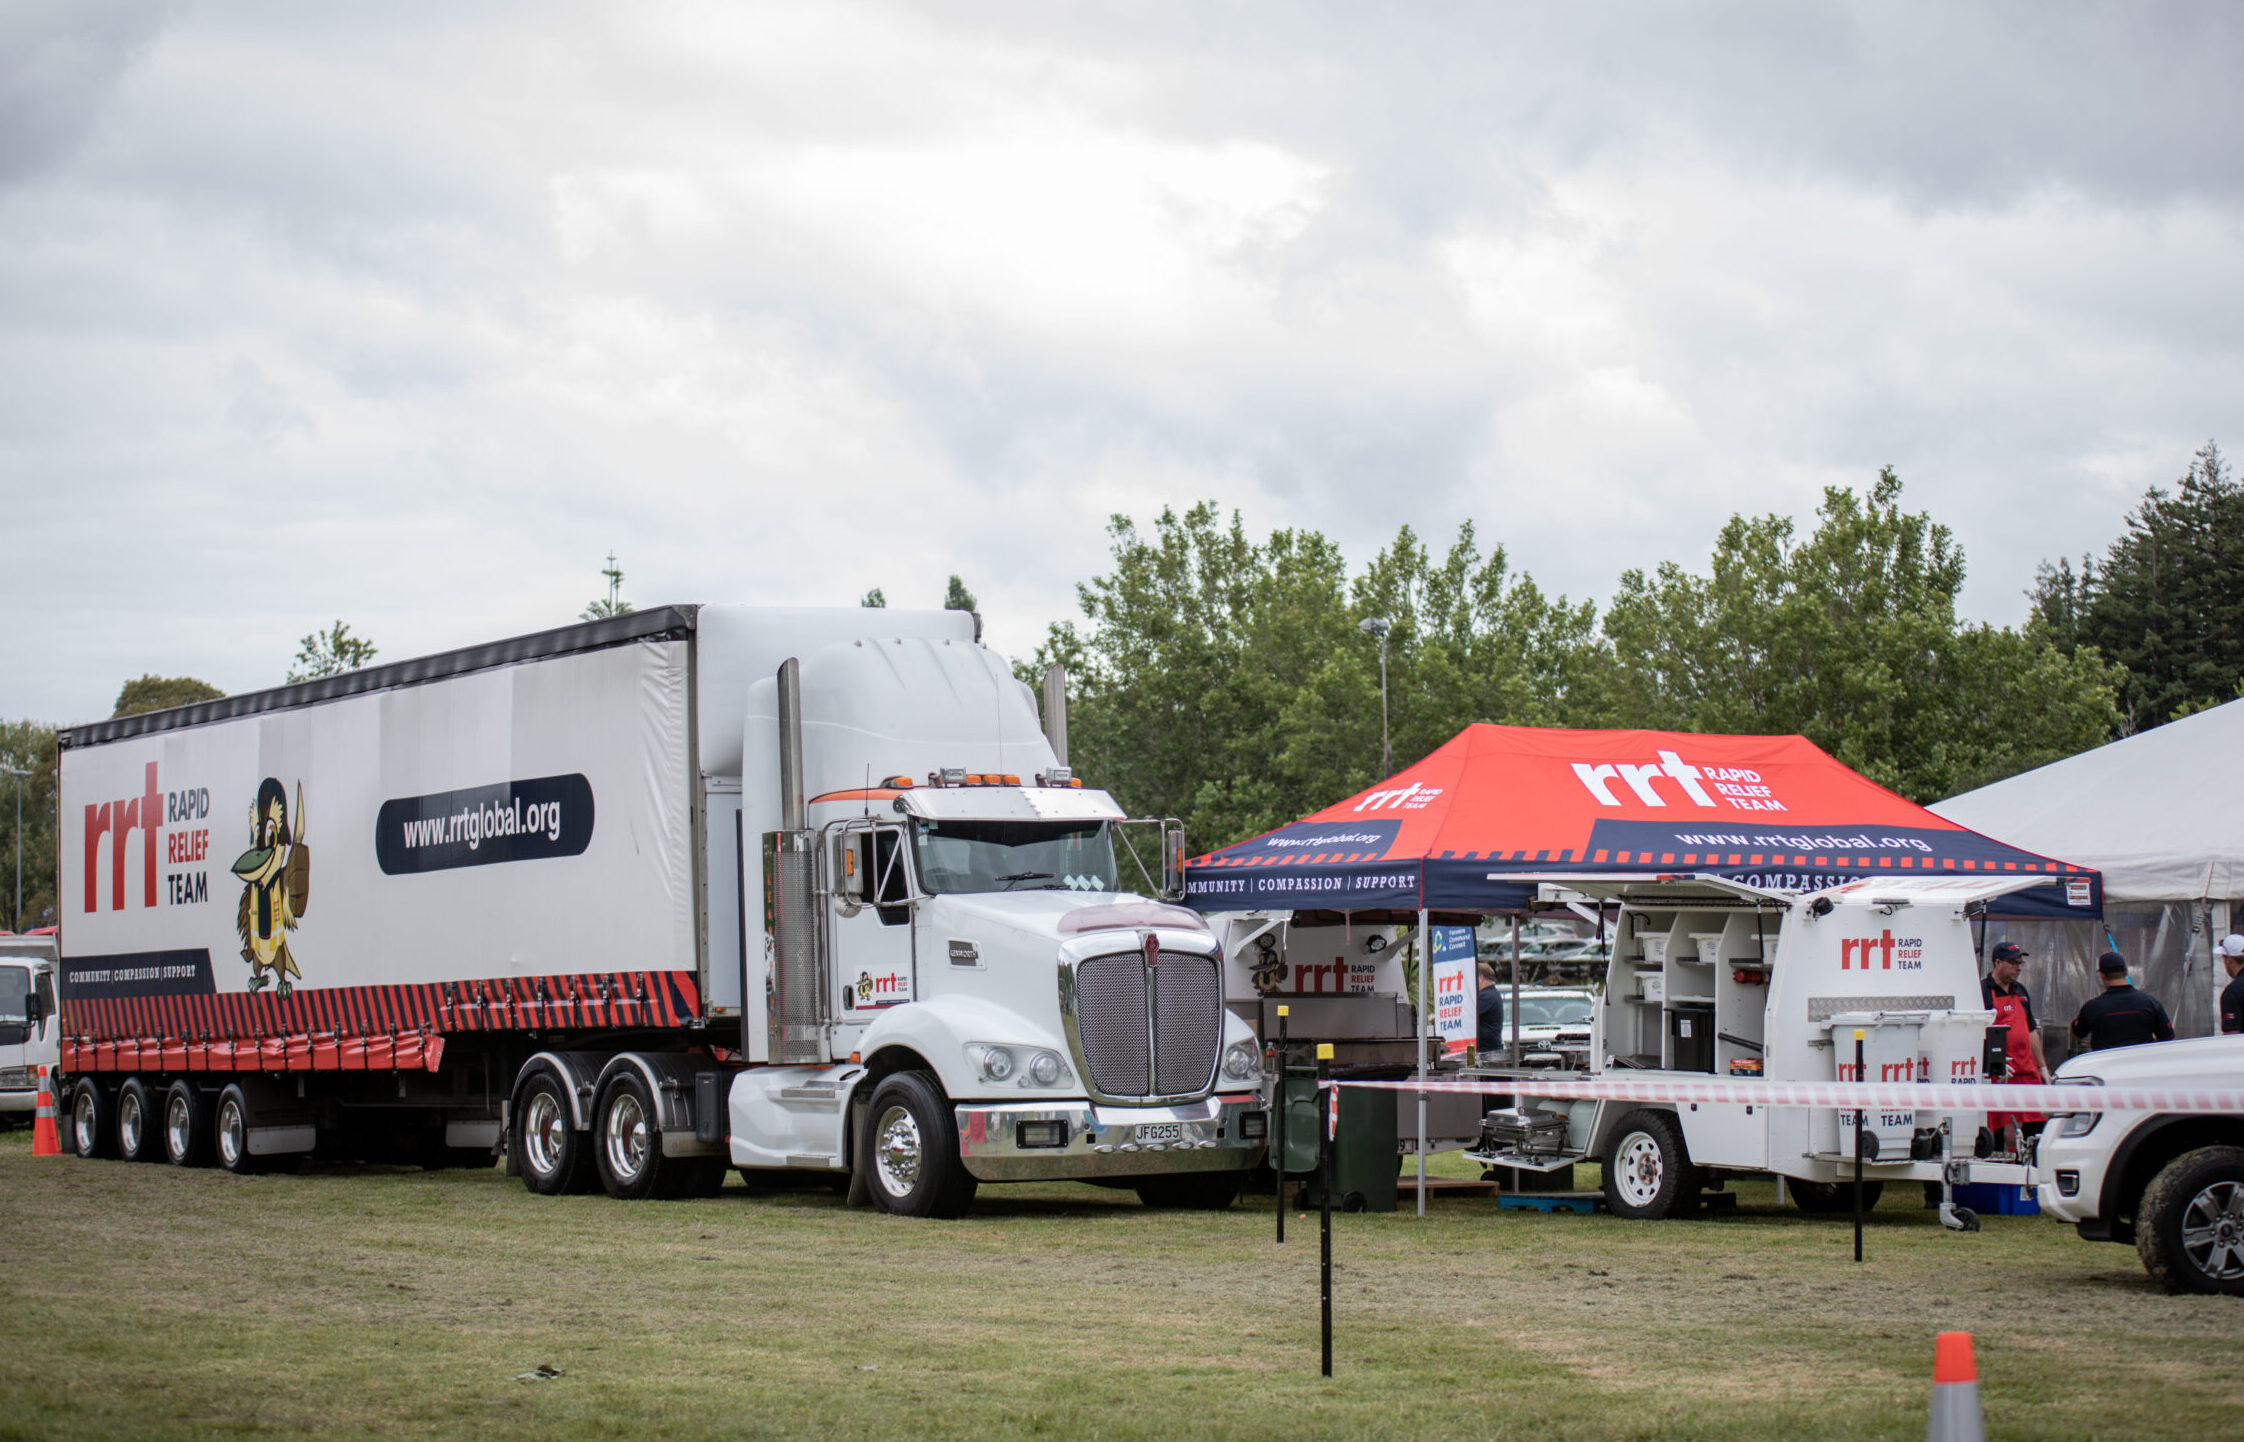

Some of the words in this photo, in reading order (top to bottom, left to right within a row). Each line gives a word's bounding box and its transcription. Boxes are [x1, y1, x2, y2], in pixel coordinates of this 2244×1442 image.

[1570, 750, 1717, 807] rrt
[1702, 766, 1761, 783] RAPID
[1353, 782, 1423, 811] rrt
[1714, 783, 1771, 797] RELIEF
[168, 787, 210, 823] RAPID
[1725, 797, 1788, 811] TEAM
[404, 797, 560, 850] www.rrtglobal.org
[84, 761, 164, 913] rrt
[1675, 833, 1933, 852] www.rrtglobal.org
[168, 829, 209, 865] RELIEF
[168, 871, 208, 905] TEAM
[1187, 879, 1245, 894] MMUNITY
[1258, 877, 1342, 892] COMPASSION
[1355, 875, 1415, 889] SUPPORT
[1732, 873, 1861, 891] OMPASSI
[1841, 929, 1895, 969] rrt
[1898, 939, 1922, 947] RAPID
[1898, 949, 1922, 958] RELIEF
[69, 970, 111, 983] COMMUNITY
[114, 966, 160, 981] COMPASSION
[163, 964, 196, 978] SUPPORT
[1351, 965, 1375, 973] RAPID
[1898, 960, 1922, 969] TEAM
[876, 972, 896, 992] rrt
[1295, 957, 1348, 992] rrt
[1351, 975, 1375, 983] RELIEF
[1439, 970, 1463, 993] rrt
[1439, 995, 1463, 1007] RAPID
[1440, 1006, 1463, 1019] RELIEF
[1440, 1019, 1462, 1031] TEAM
[1881, 1057, 1914, 1082] rrt
[1917, 1057, 1929, 1076] rt
[1951, 1056, 1976, 1075] rrt
[1881, 1113, 1912, 1126] TEAM
[1136, 1125, 1179, 1139] JFG255
